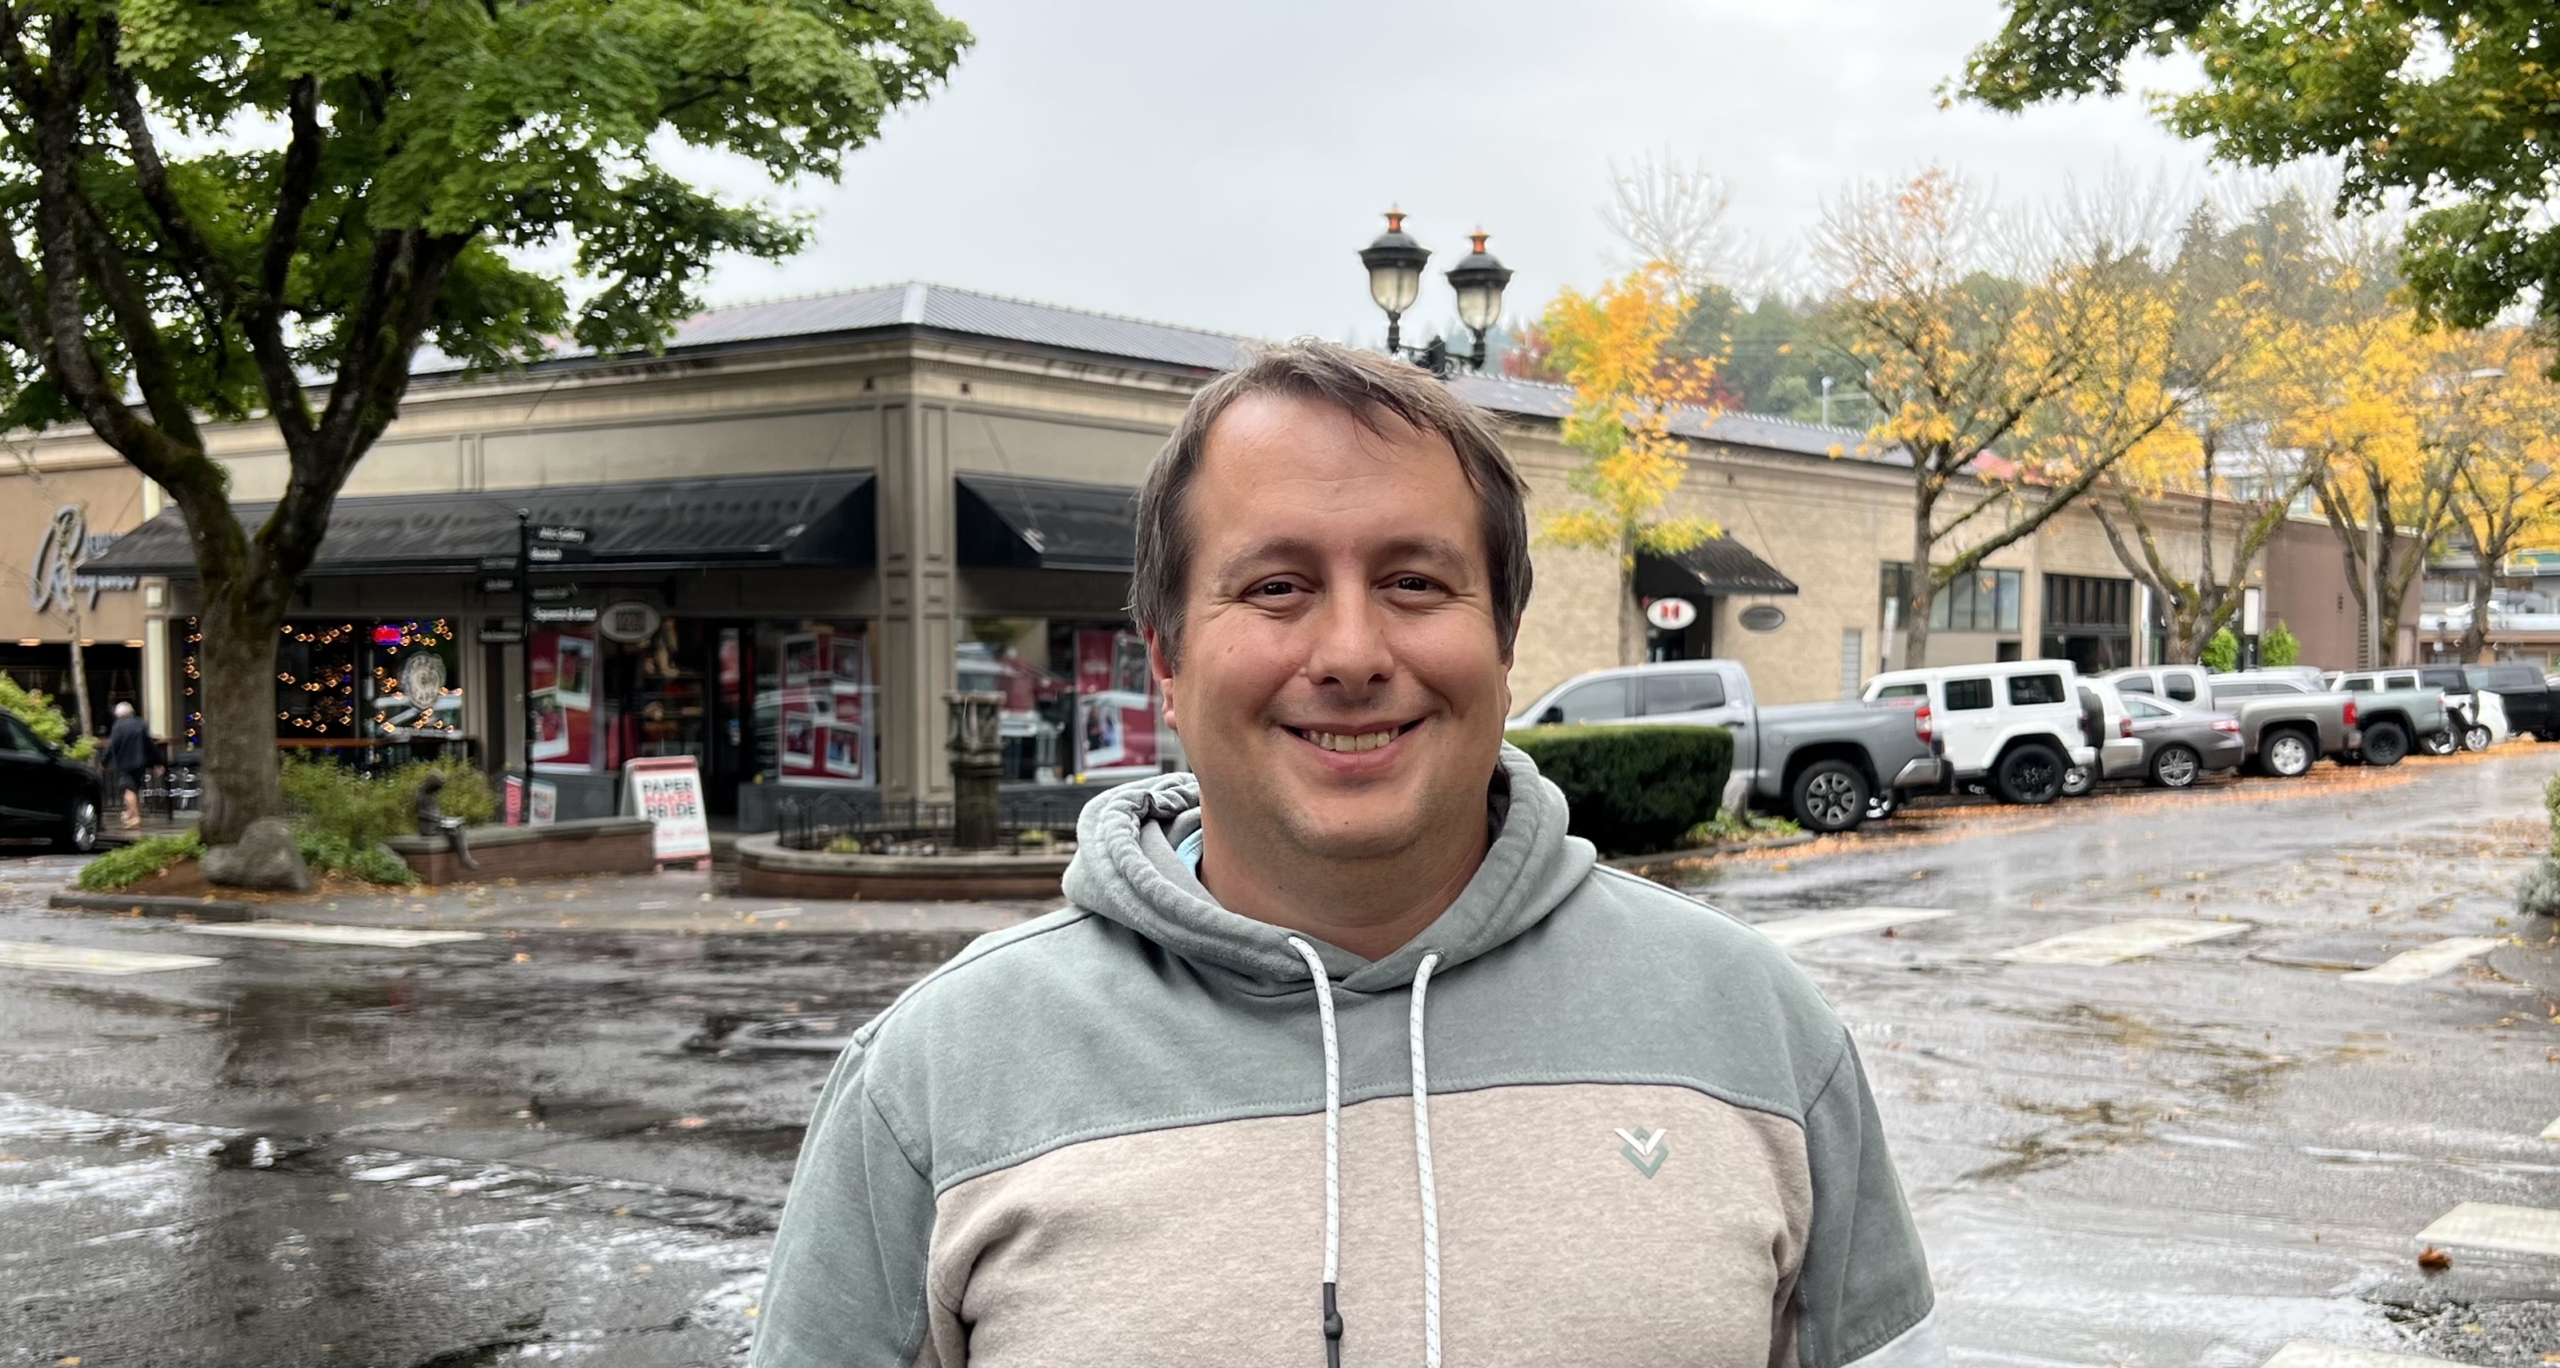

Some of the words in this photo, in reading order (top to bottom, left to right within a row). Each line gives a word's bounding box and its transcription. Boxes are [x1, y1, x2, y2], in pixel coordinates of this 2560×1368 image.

[643, 778, 693, 792] PAPER
[644, 790, 695, 805] MAKER
[647, 803, 697, 819] PRIDE
